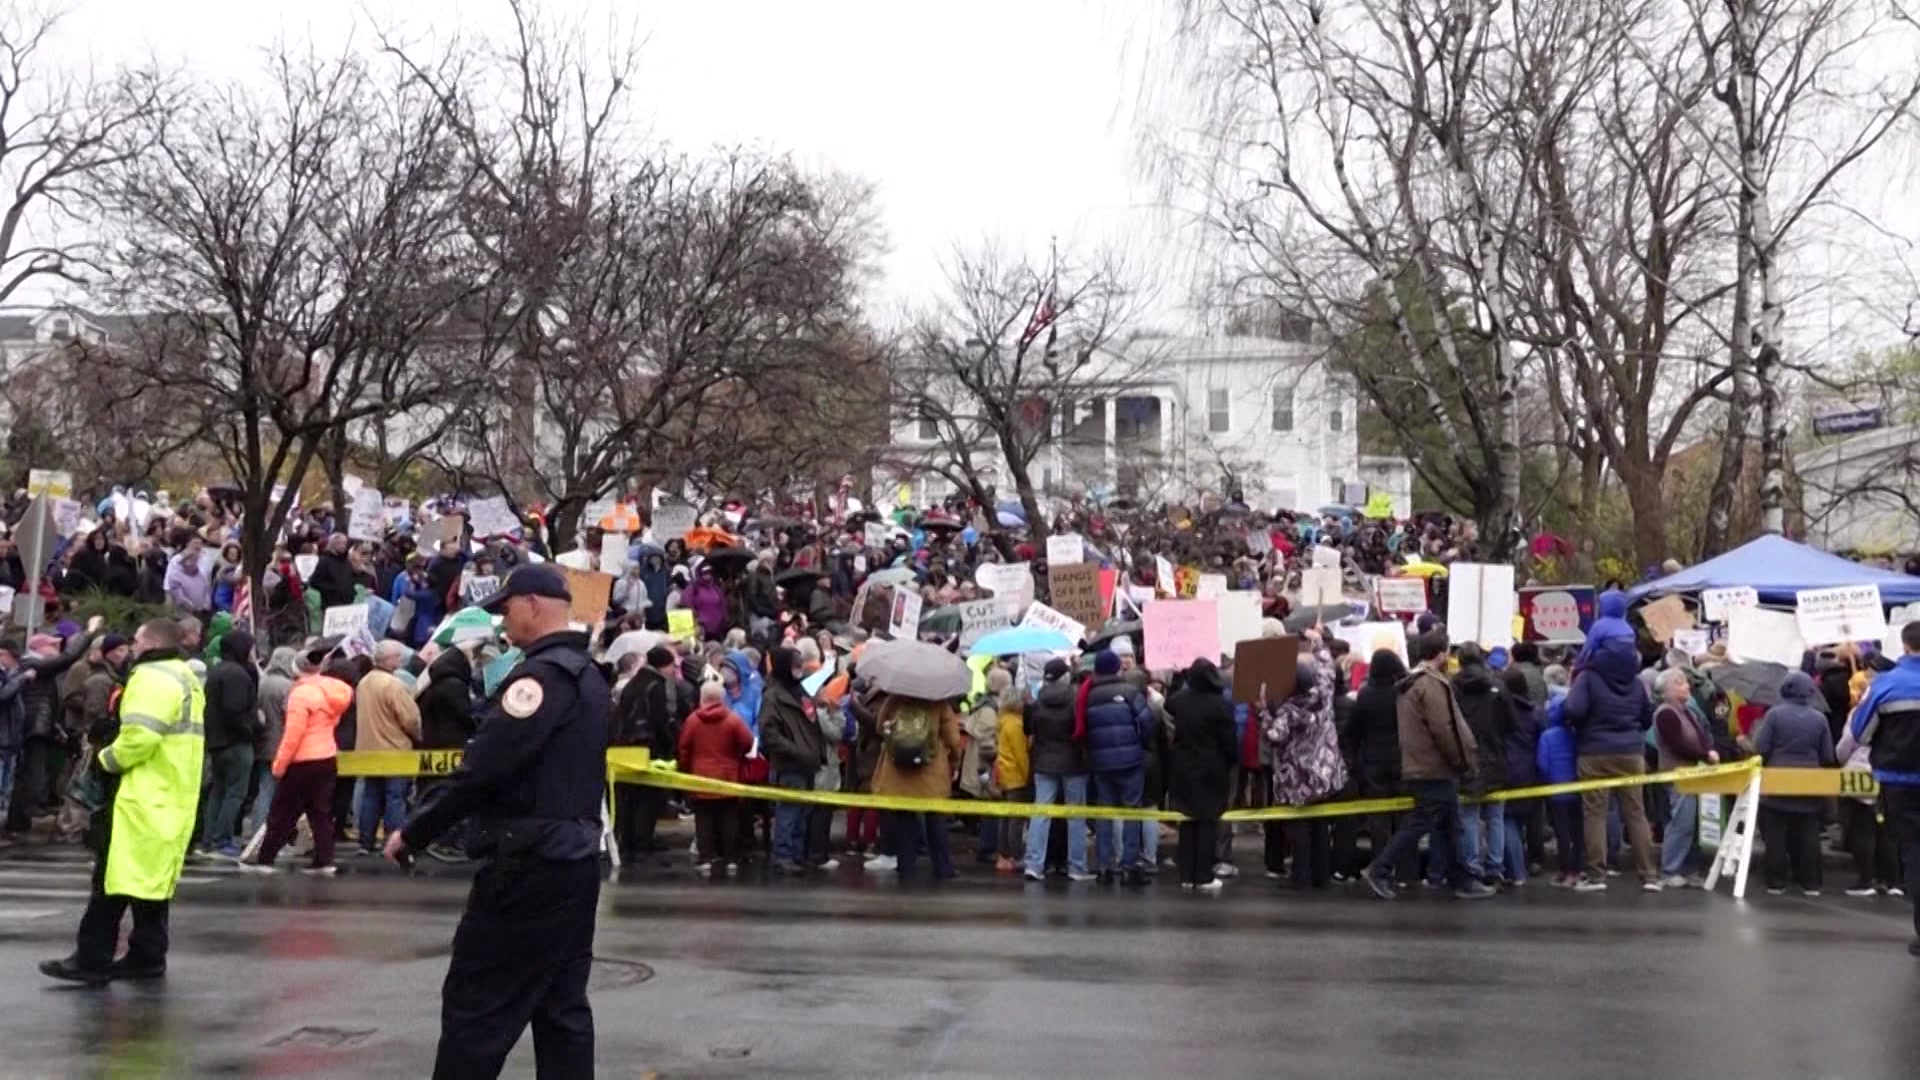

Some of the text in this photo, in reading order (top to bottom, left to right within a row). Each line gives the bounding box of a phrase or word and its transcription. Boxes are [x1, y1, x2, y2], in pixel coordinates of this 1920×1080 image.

[1053, 572, 1092, 583] HANDS
[1801, 589, 1874, 604] HANDS OFF
[966, 602, 996, 619] CUT
